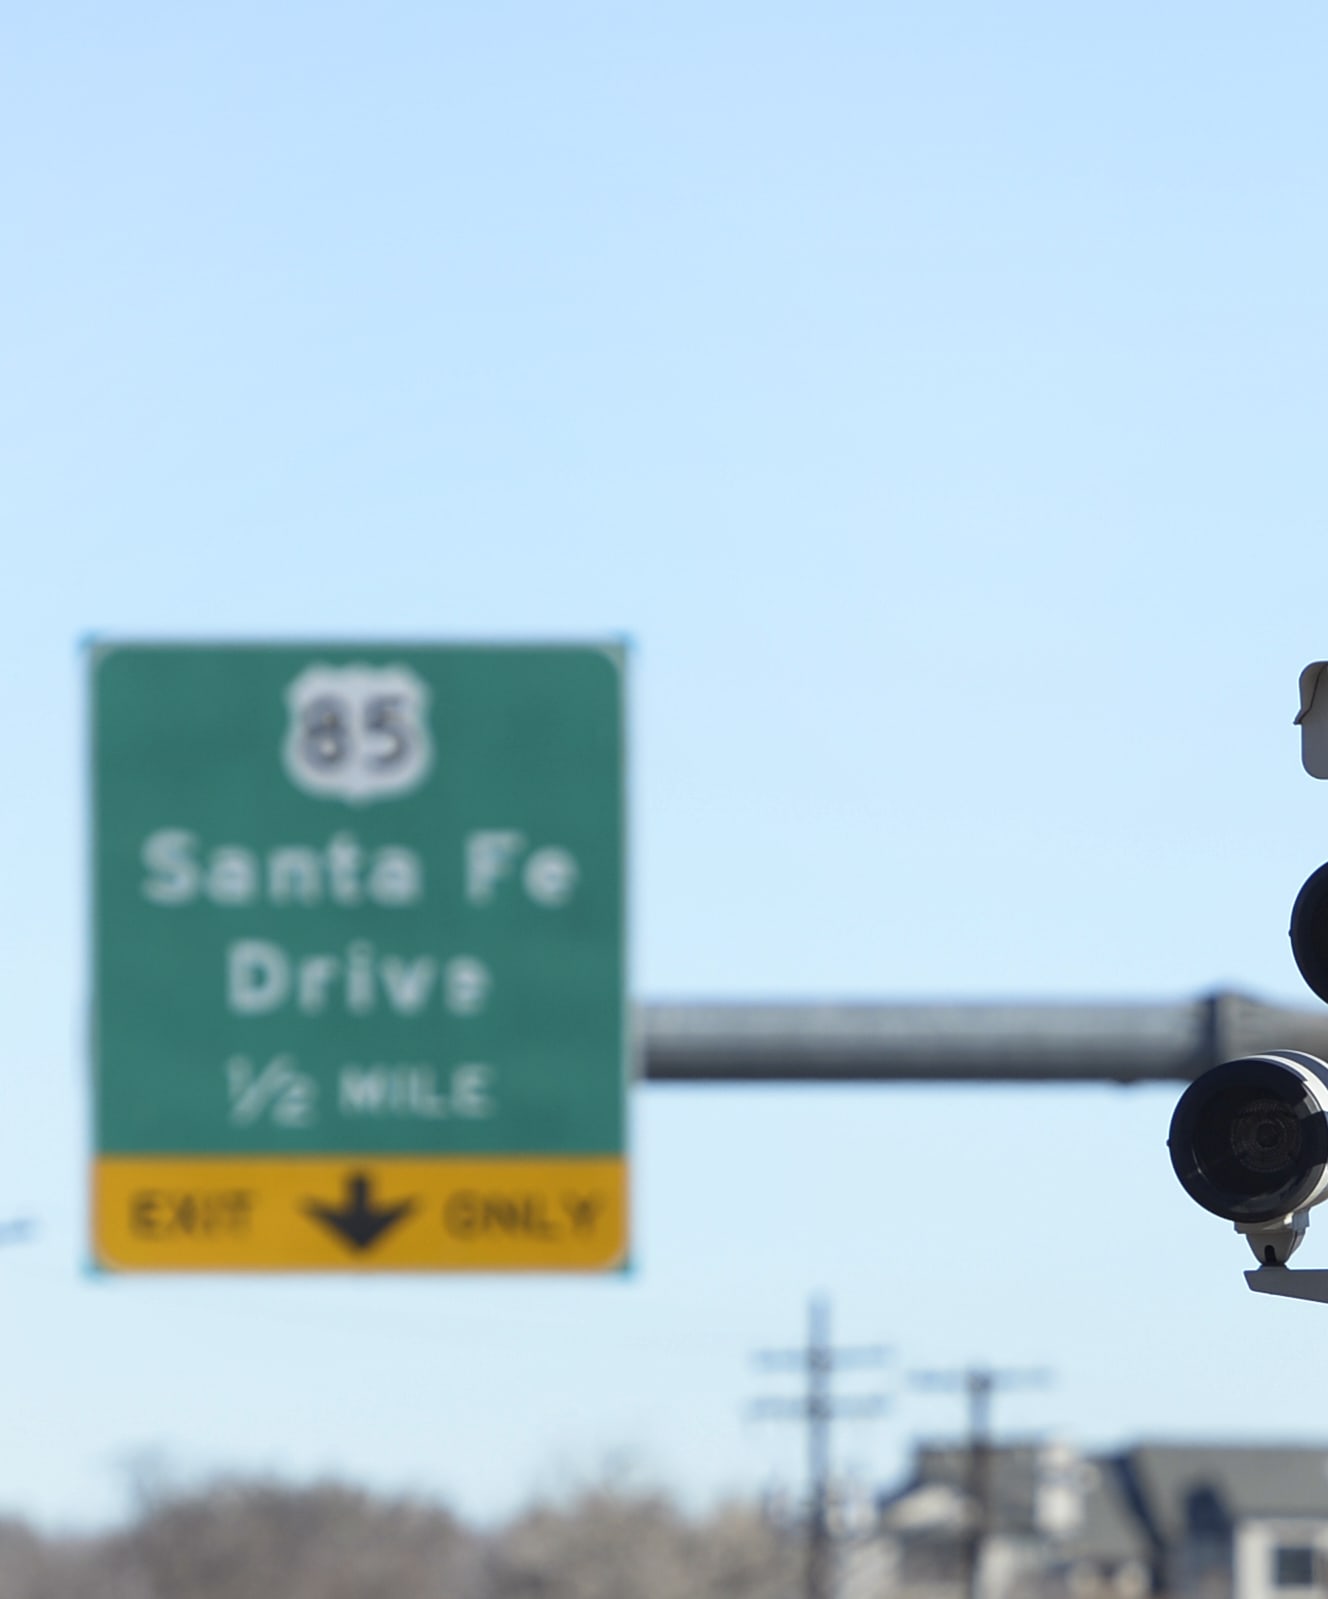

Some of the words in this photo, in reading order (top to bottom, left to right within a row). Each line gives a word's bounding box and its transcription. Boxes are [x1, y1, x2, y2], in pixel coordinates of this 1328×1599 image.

[303, 695, 409, 773] 85
[141, 828, 422, 906] Santa
[465, 829, 579, 906] Fe
[227, 938, 491, 1014] Drive
[338, 1064, 494, 1118] MILE
[130, 1191, 252, 1239] EXIT
[443, 1191, 602, 1239] ONLY
